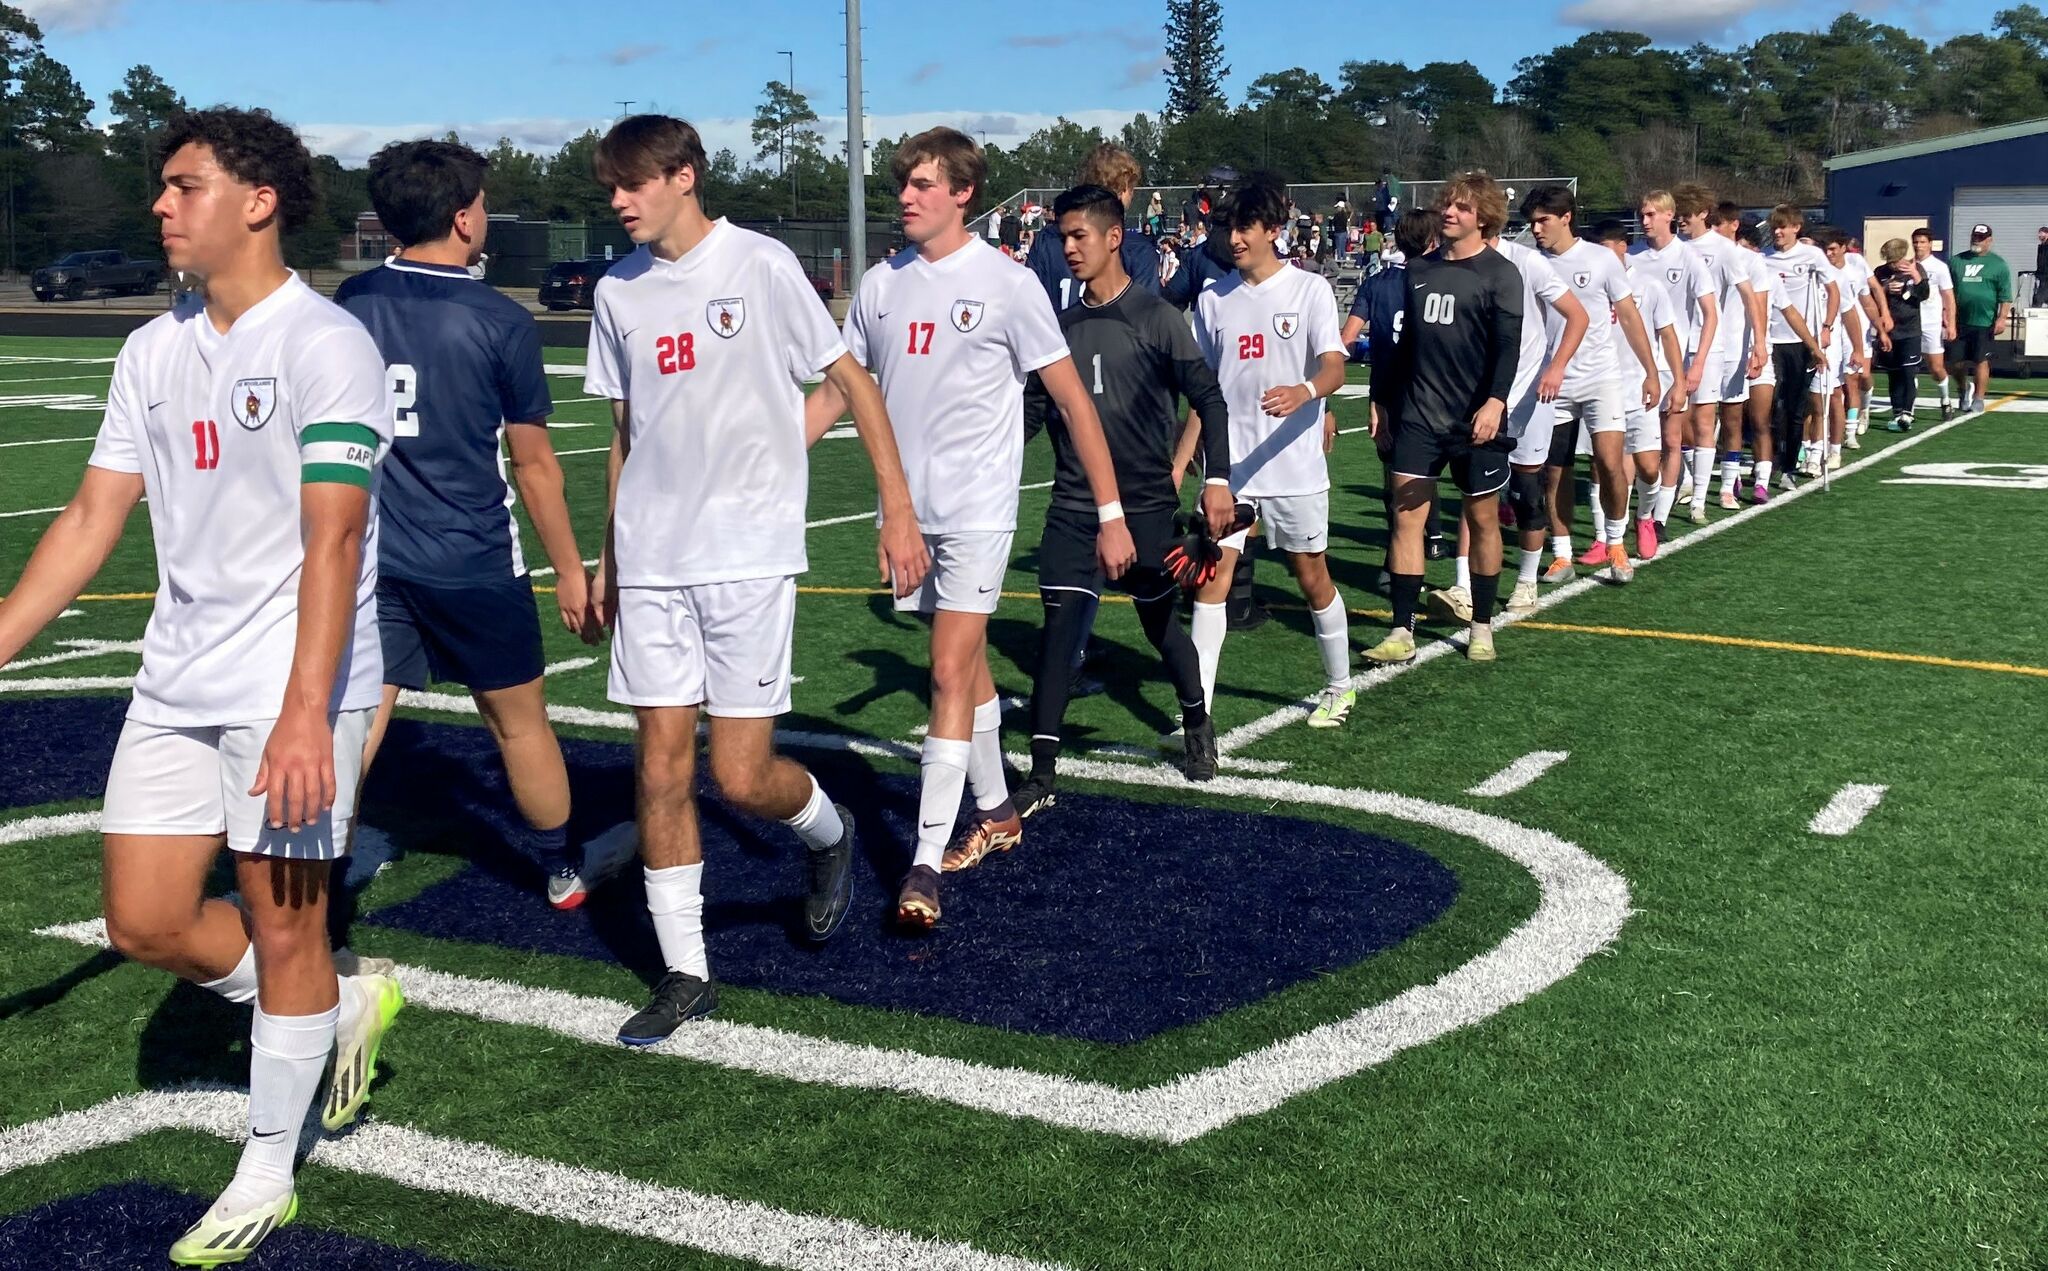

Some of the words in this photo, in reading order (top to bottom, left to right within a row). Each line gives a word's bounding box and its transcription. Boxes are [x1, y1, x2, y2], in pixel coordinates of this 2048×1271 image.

[1965, 264, 1985, 277] W
[1423, 293, 1455, 325] 00
[656, 332, 696, 375] 28
[907, 322, 936, 355] 17
[1238, 333, 1264, 360] 29
[1092, 353, 1104, 394] 1
[386, 364, 419, 437] 2
